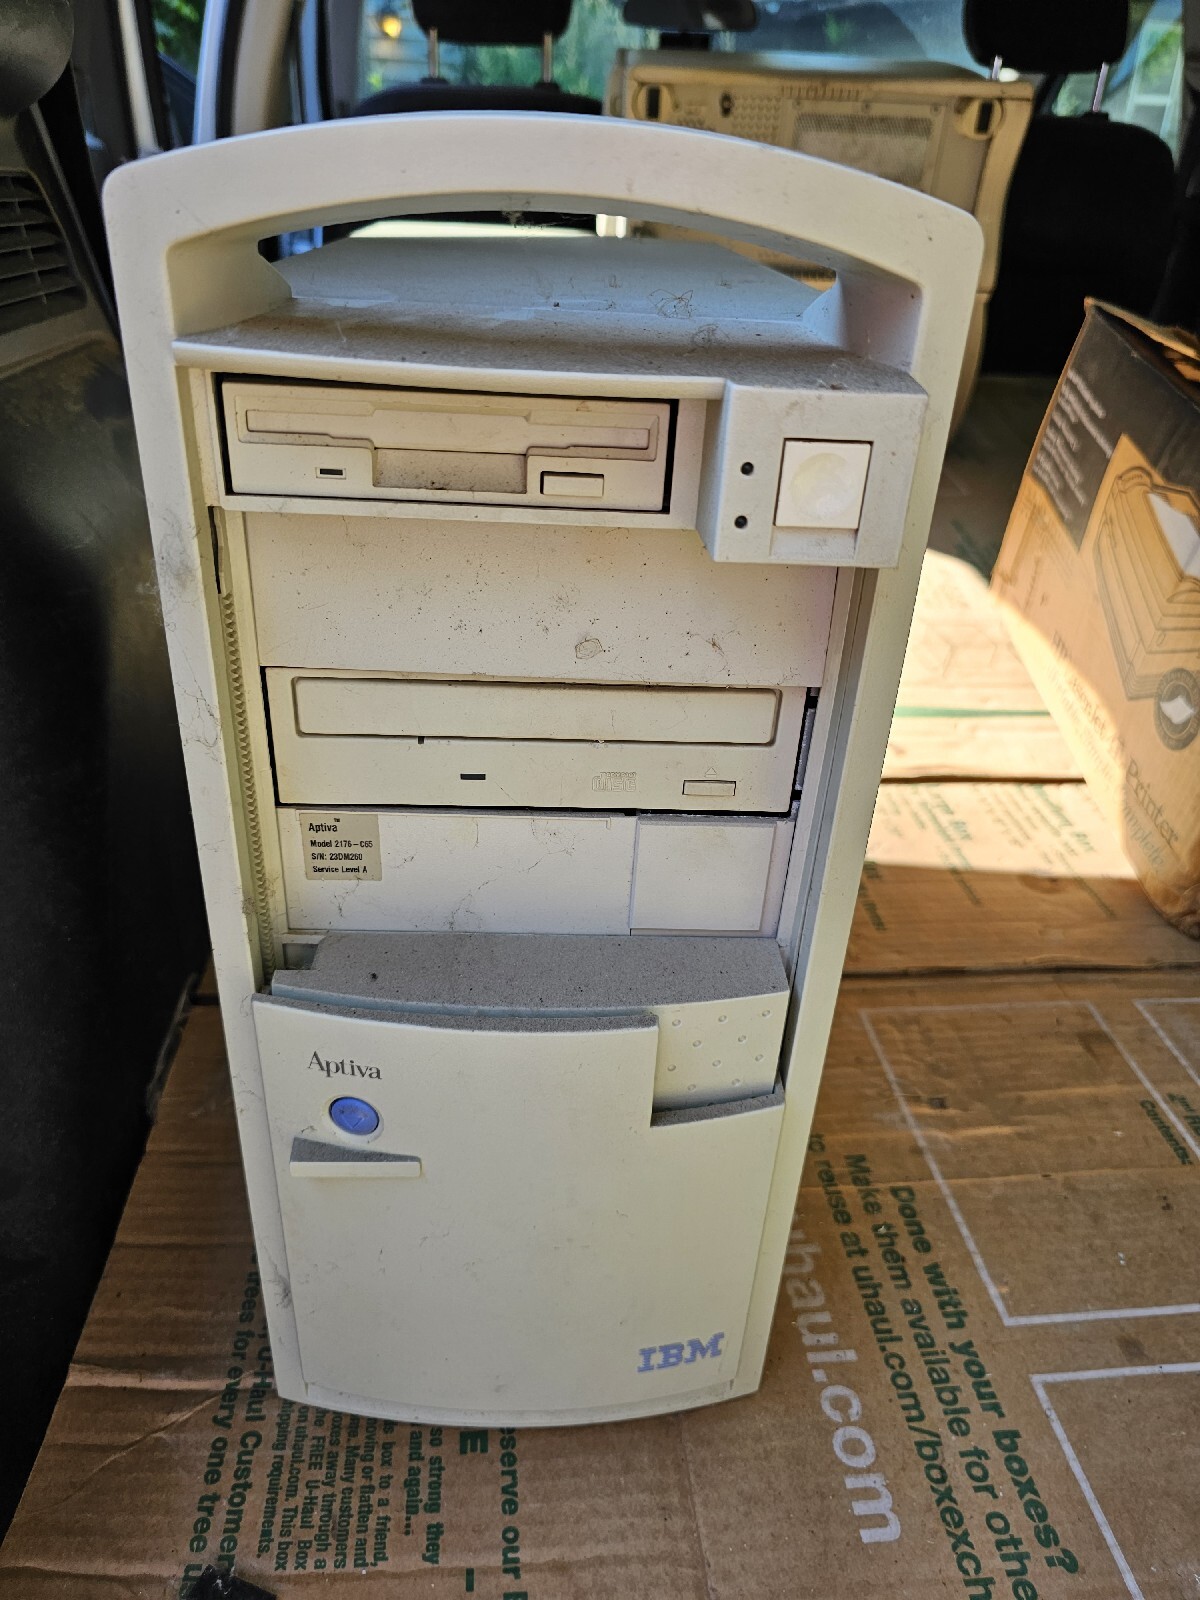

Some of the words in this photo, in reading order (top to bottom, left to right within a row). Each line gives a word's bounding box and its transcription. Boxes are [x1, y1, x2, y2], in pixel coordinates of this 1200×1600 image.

[310, 840, 332, 848] Model
[311, 853, 327, 861] S/N:
[312, 865, 339, 873] Service
[341, 865, 360, 873] Level
[362, 865, 368, 873] A
[307, 1050, 383, 1080] Aptiva
[814, 1159, 852, 1225] reuse
[839, 1231, 869, 1259] at
[232, 1329, 255, 1360] for
[843, 1153, 882, 1216] Make
[871, 1221, 912, 1290] them
[901, 1298, 972, 1437] available
[958, 1445, 999, 1500] for
[637, 1331, 725, 1372] IBM
[211, 1365, 244, 1430] every
[889, 1185, 932, 1254] Done
[922, 1262, 969, 1330] with
[948, 1339, 1006, 1419] your
[991, 1429, 1079, 1575] boxes?
[203, 1436, 229, 1486] one
[307, 1435, 326, 1471] FREE
[340, 1445, 361, 1484] Many
[380, 1441, 396, 1467] box
[408, 1430, 425, 1462] and
[321, 1451, 339, 1488] away
[361, 1465, 375, 1482] or
[378, 1473, 394, 1490] to
[423, 1455, 446, 1514] strong
[279, 1504, 299, 1538] This
[299, 1479, 321, 1530] U-Haul
[355, 1484, 376, 1535] flatten
[377, 1498, 390, 1507] a
[189, 1491, 221, 1553] tree
[313, 1491, 337, 1553] through
[333, 1487, 354, 1570] customers
[370, 1514, 391, 1567] friend,
[274, 1540, 294, 1572] box
[293, 1539, 313, 1571] Box
[353, 1537, 369, 1569] and
[421, 1521, 444, 1565] they
[501, 1525, 522, 1580] our
[313, 1558, 327, 1570] a
